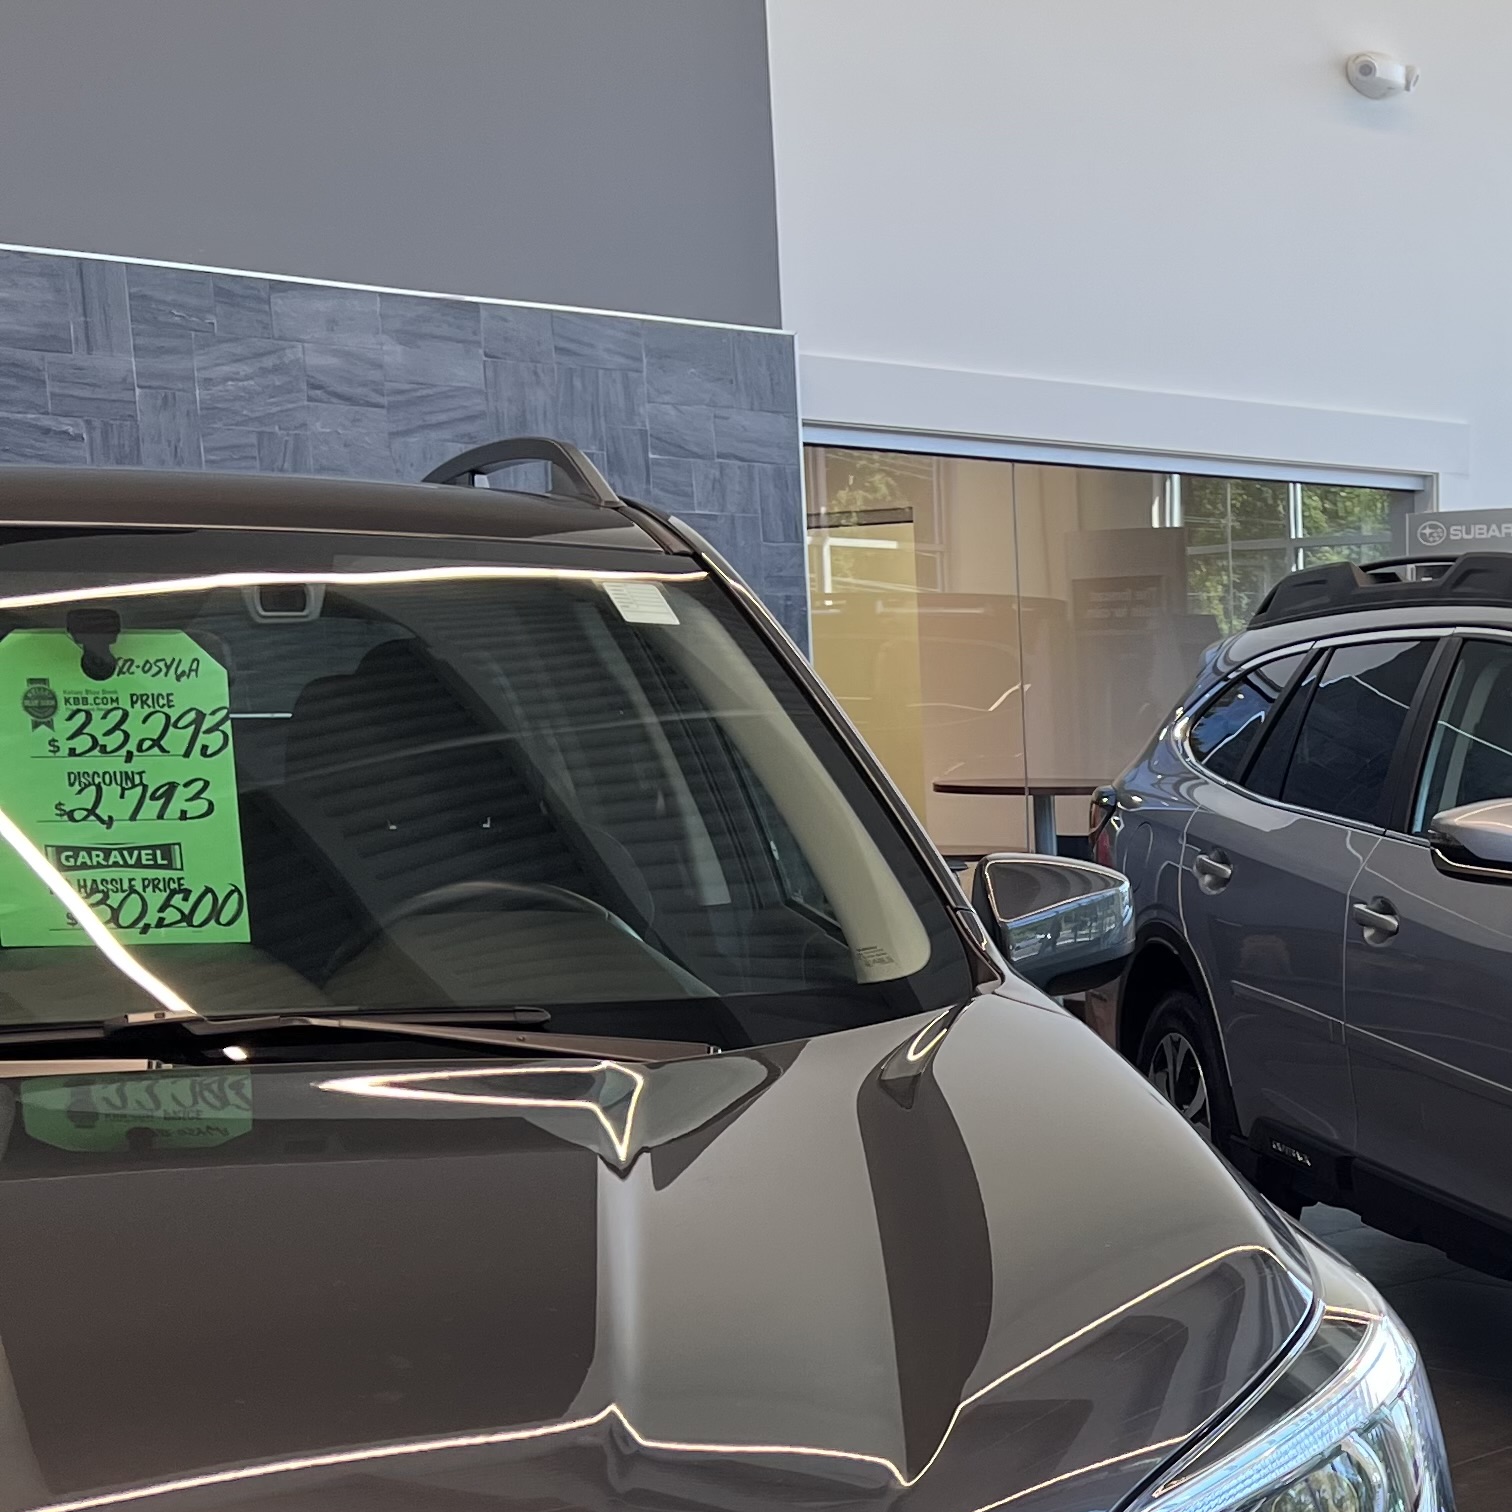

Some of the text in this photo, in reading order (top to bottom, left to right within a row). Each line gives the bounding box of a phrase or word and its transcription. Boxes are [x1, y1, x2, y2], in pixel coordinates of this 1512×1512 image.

[63, 696, 120, 706] KBB.COM
[129, 692, 175, 709] PRICE
[67, 770, 146, 787] DISCOUNT
[60, 848, 168, 867] GARAVEL
[142, 877, 185, 893] PRICE
